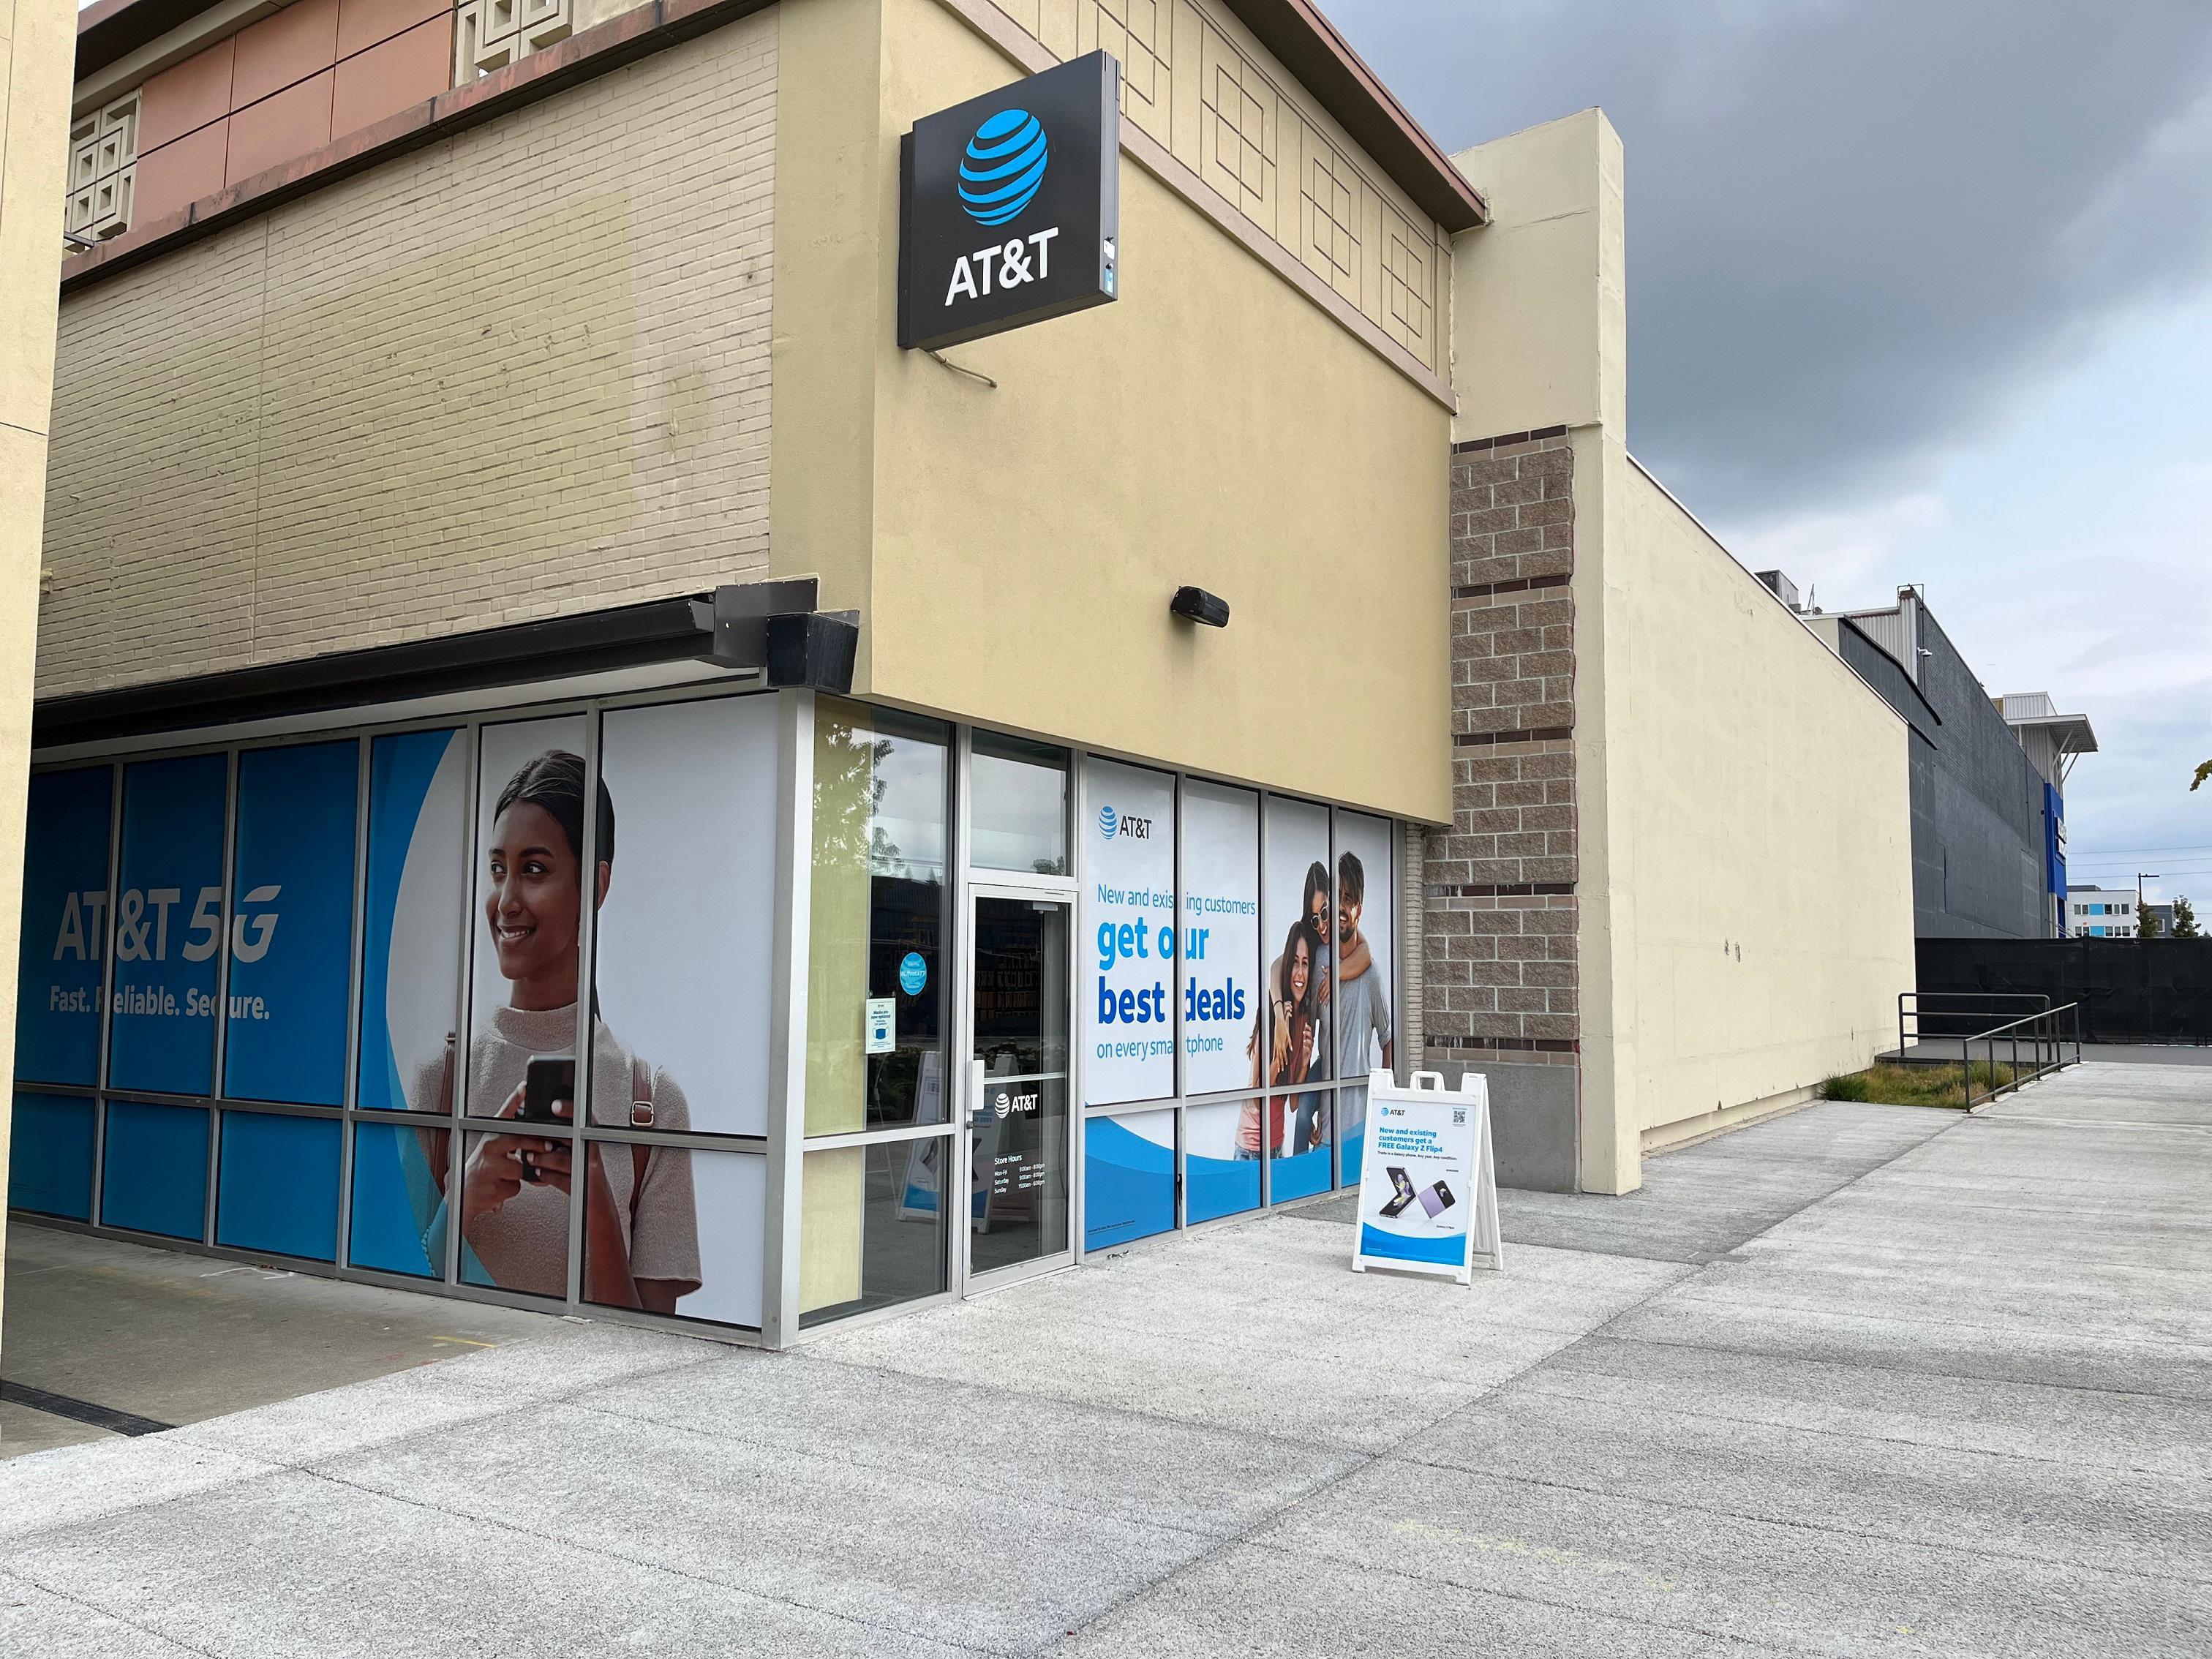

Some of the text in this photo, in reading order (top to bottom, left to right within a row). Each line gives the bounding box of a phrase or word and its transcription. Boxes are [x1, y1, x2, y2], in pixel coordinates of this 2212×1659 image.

[945, 227, 1058, 306] AT&T
[1119, 815, 1152, 839] AT&T
[1098, 884, 1255, 916] New and exising customers
[53, 885, 282, 963] AT&T 5G
[1097, 917, 1209, 971] get our
[50, 985, 90, 1012] Fast.
[1099, 976, 1245, 1024] best deals
[1097, 1034, 1223, 1061] on every smatphone
[1012, 1094, 1038, 1112] AT&T
[1410, 1129, 1437, 1138] existing
[1396, 1143, 1418, 1152] Galaxy
[1426, 1146, 1442, 1154] Flip4
